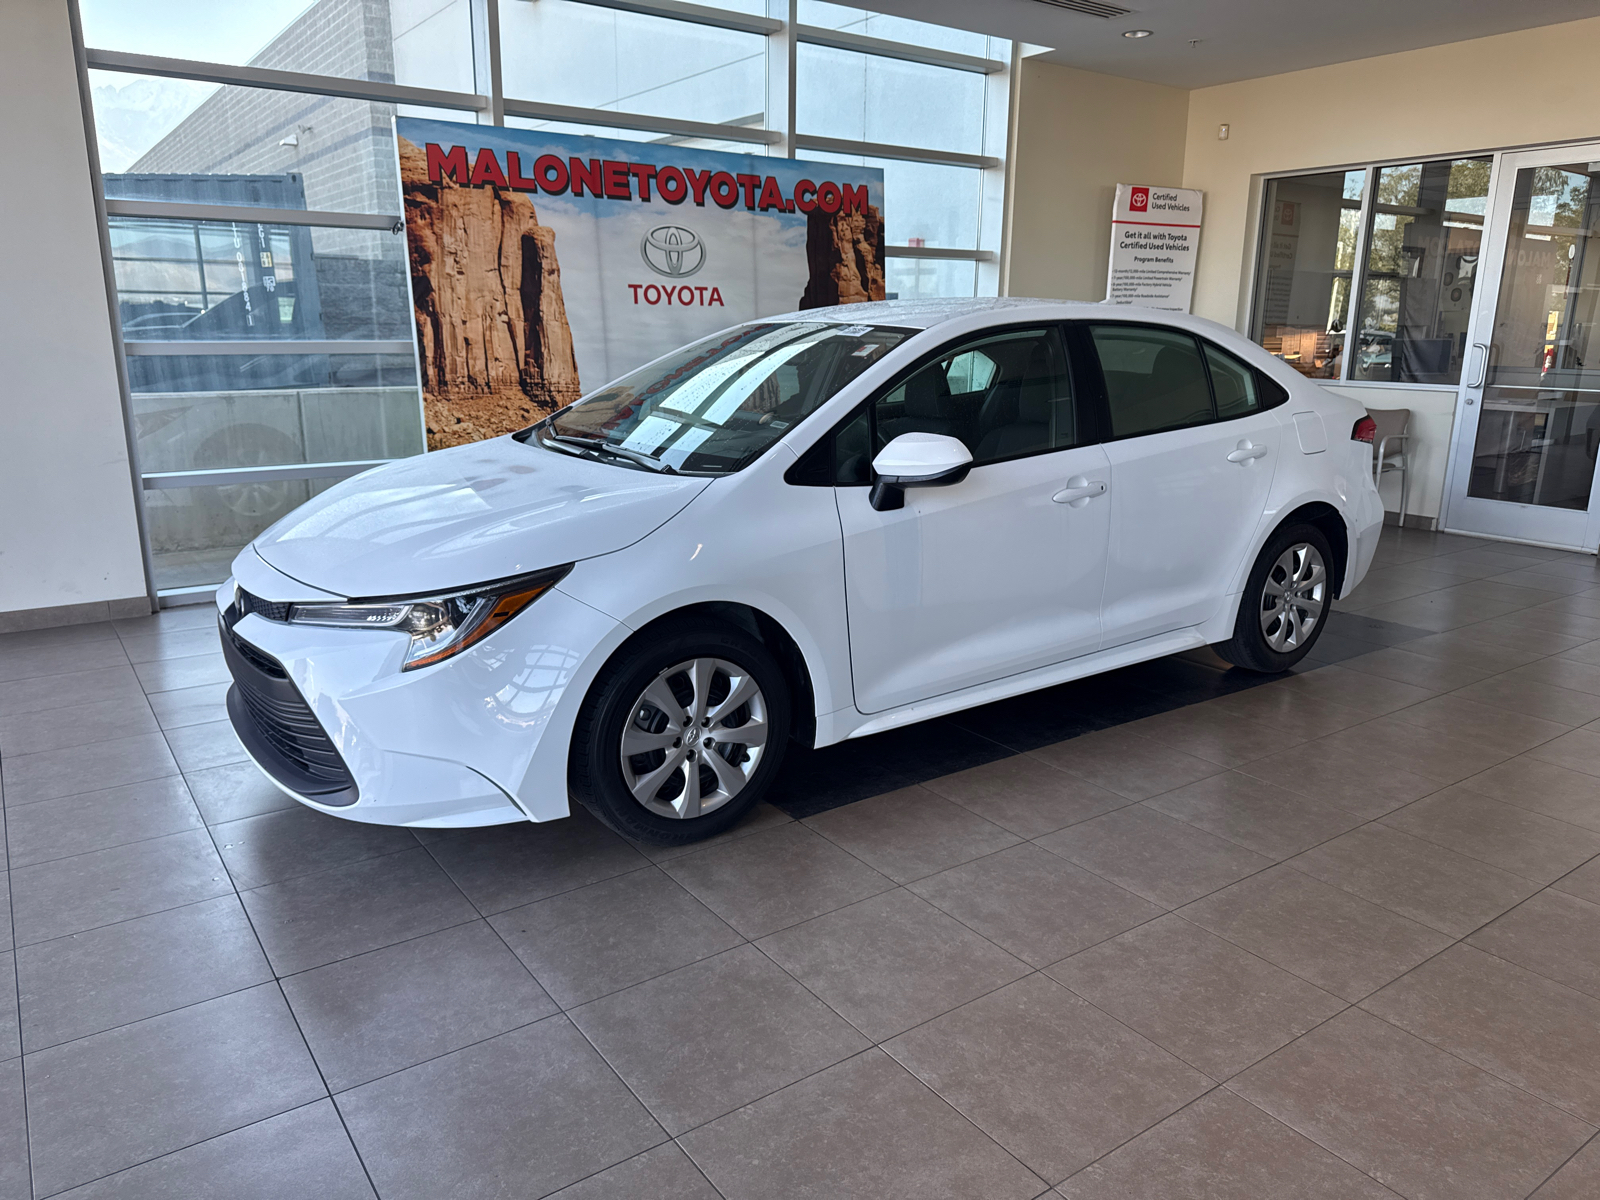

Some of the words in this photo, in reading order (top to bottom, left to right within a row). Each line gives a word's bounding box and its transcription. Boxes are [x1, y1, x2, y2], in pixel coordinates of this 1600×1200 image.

[425, 142, 869, 216] MALONETOYOTA.COM
[1152, 193, 1178, 202] Certified
[1151, 202, 1167, 210] Used
[1167, 203, 1190, 212] Vehicles
[1124, 231, 1137, 239] Get
[1137, 231, 1142, 240] it
[1143, 232, 1152, 240] all
[1152, 232, 1167, 241] with
[1167, 233, 1188, 242] Toyota
[1119, 241, 1148, 250] Certified
[1148, 242, 1164, 251] Used
[1165, 243, 1190, 252] Vehicles
[1133, 256, 1154, 264] Program
[1155, 256, 1174, 264] Benefits
[627, 283, 725, 307] TOYOTA
